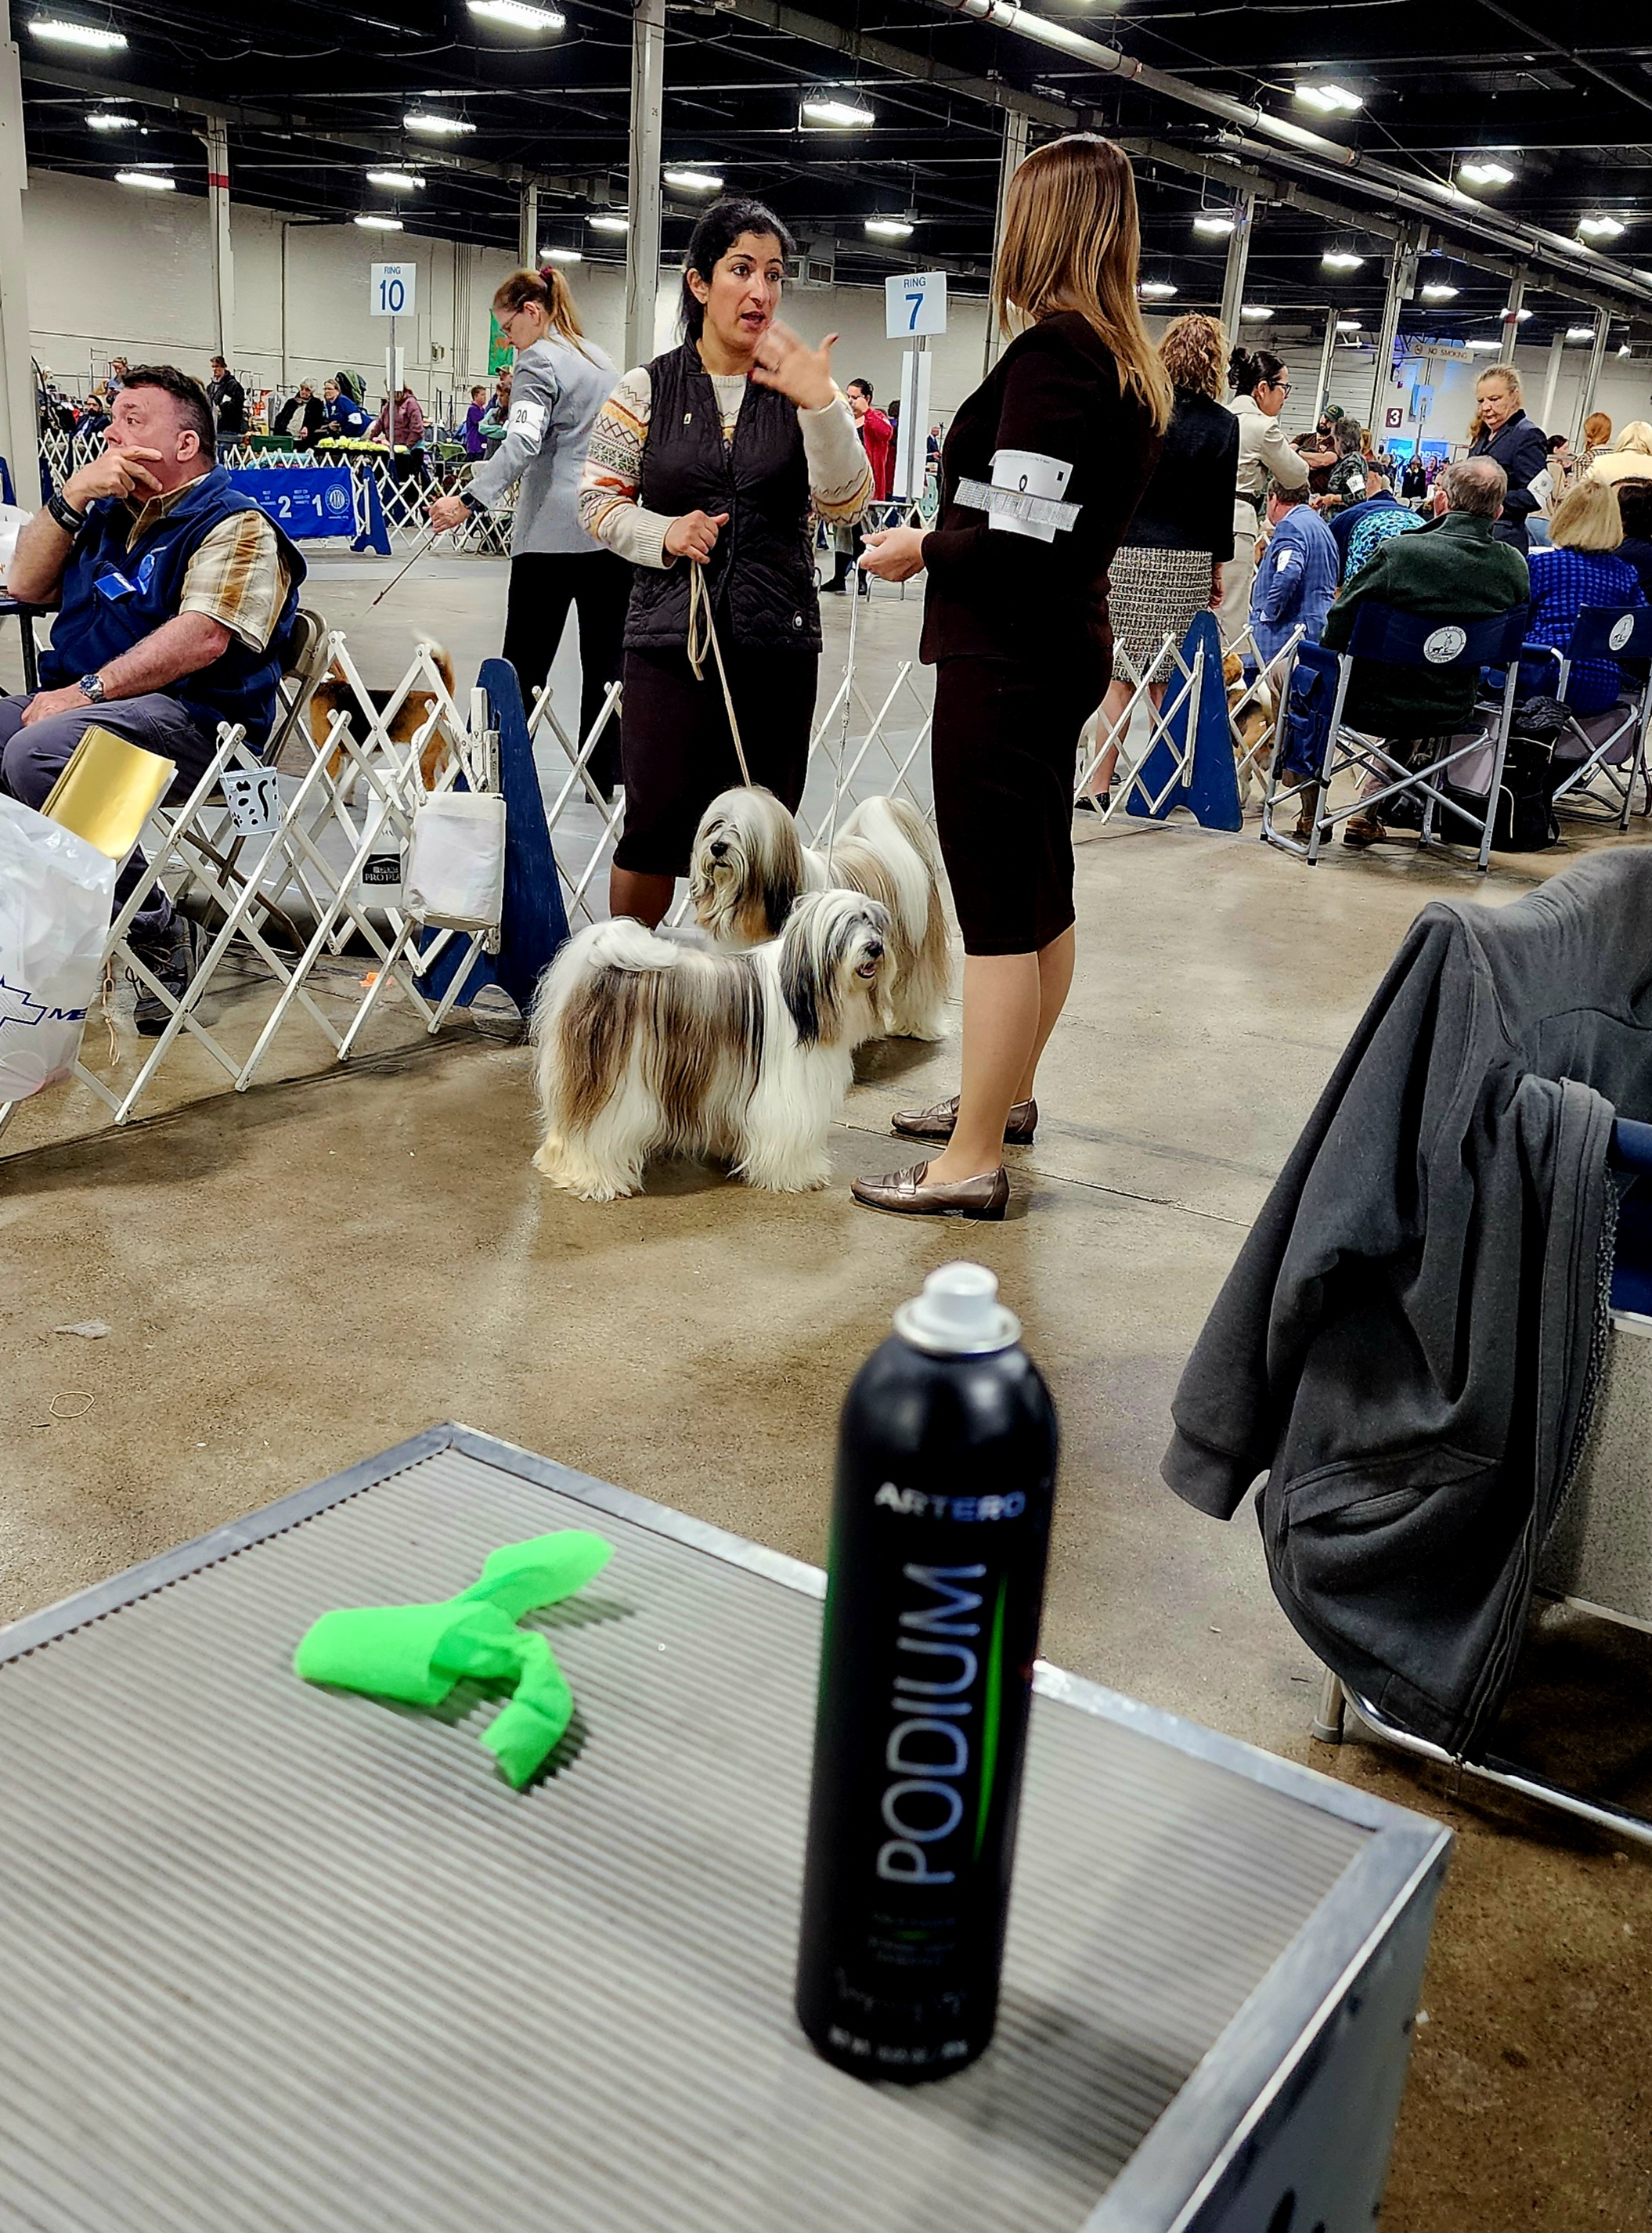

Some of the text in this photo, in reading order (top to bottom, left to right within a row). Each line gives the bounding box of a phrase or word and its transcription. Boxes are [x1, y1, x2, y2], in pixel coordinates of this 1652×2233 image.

[904, 277, 926, 288] RING
[380, 280, 404, 312] 10
[905, 293, 923, 330] 7
[1441, 350, 1467, 359] SMOKING
[515, 409, 528, 423] 20
[1389, 409, 1400, 424] 3
[278, 496, 292, 518] 2
[312, 494, 323, 516] 1
[365, 873, 384, 882] PRO
[874, 1481, 1026, 1522] ARTERO
[876, 1563, 987, 1885] PODIUM
